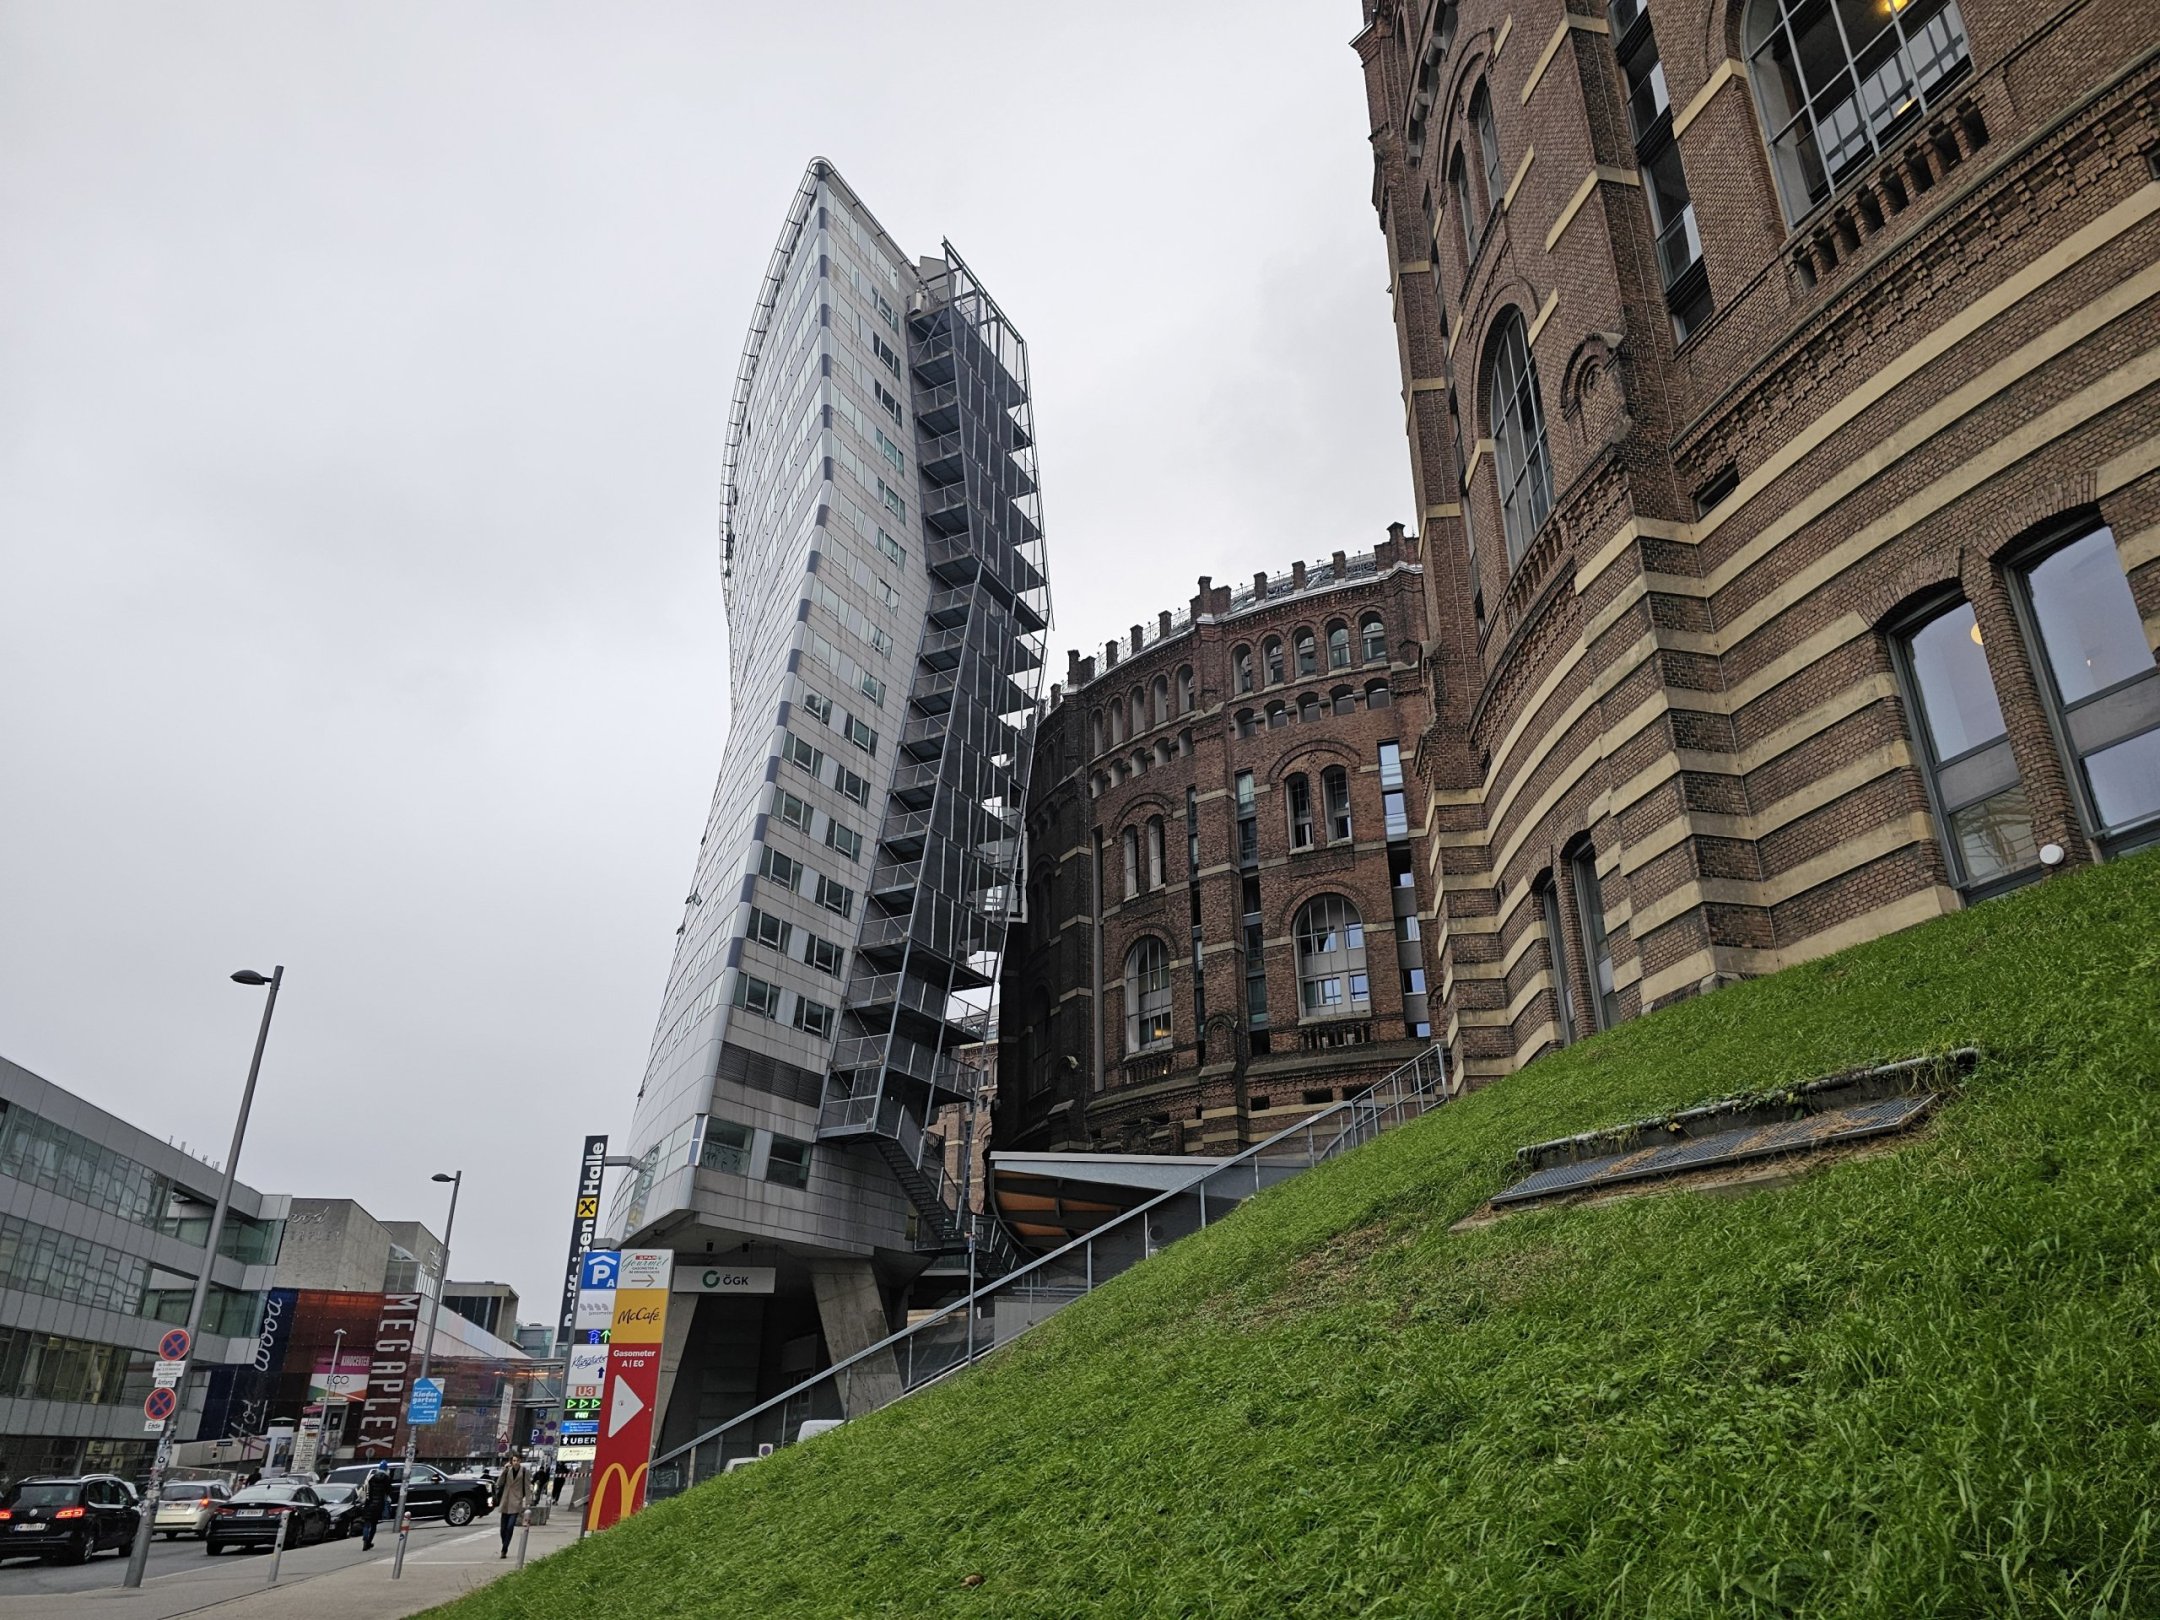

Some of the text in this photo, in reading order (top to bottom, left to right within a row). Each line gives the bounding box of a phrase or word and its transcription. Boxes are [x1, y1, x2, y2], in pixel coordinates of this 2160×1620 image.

[582, 1142, 605, 1196] Halle
[591, 1265, 610, 1285] P
[723, 1274, 749, 1286] ÖGK
[617, 1307, 660, 1325] McCafé
[358, 1294, 420, 1449] MEGAPLEX
[578, 1386, 594, 1396] U3
[412, 1397, 437, 1405] garten
[570, 1437, 597, 1445] UBER
